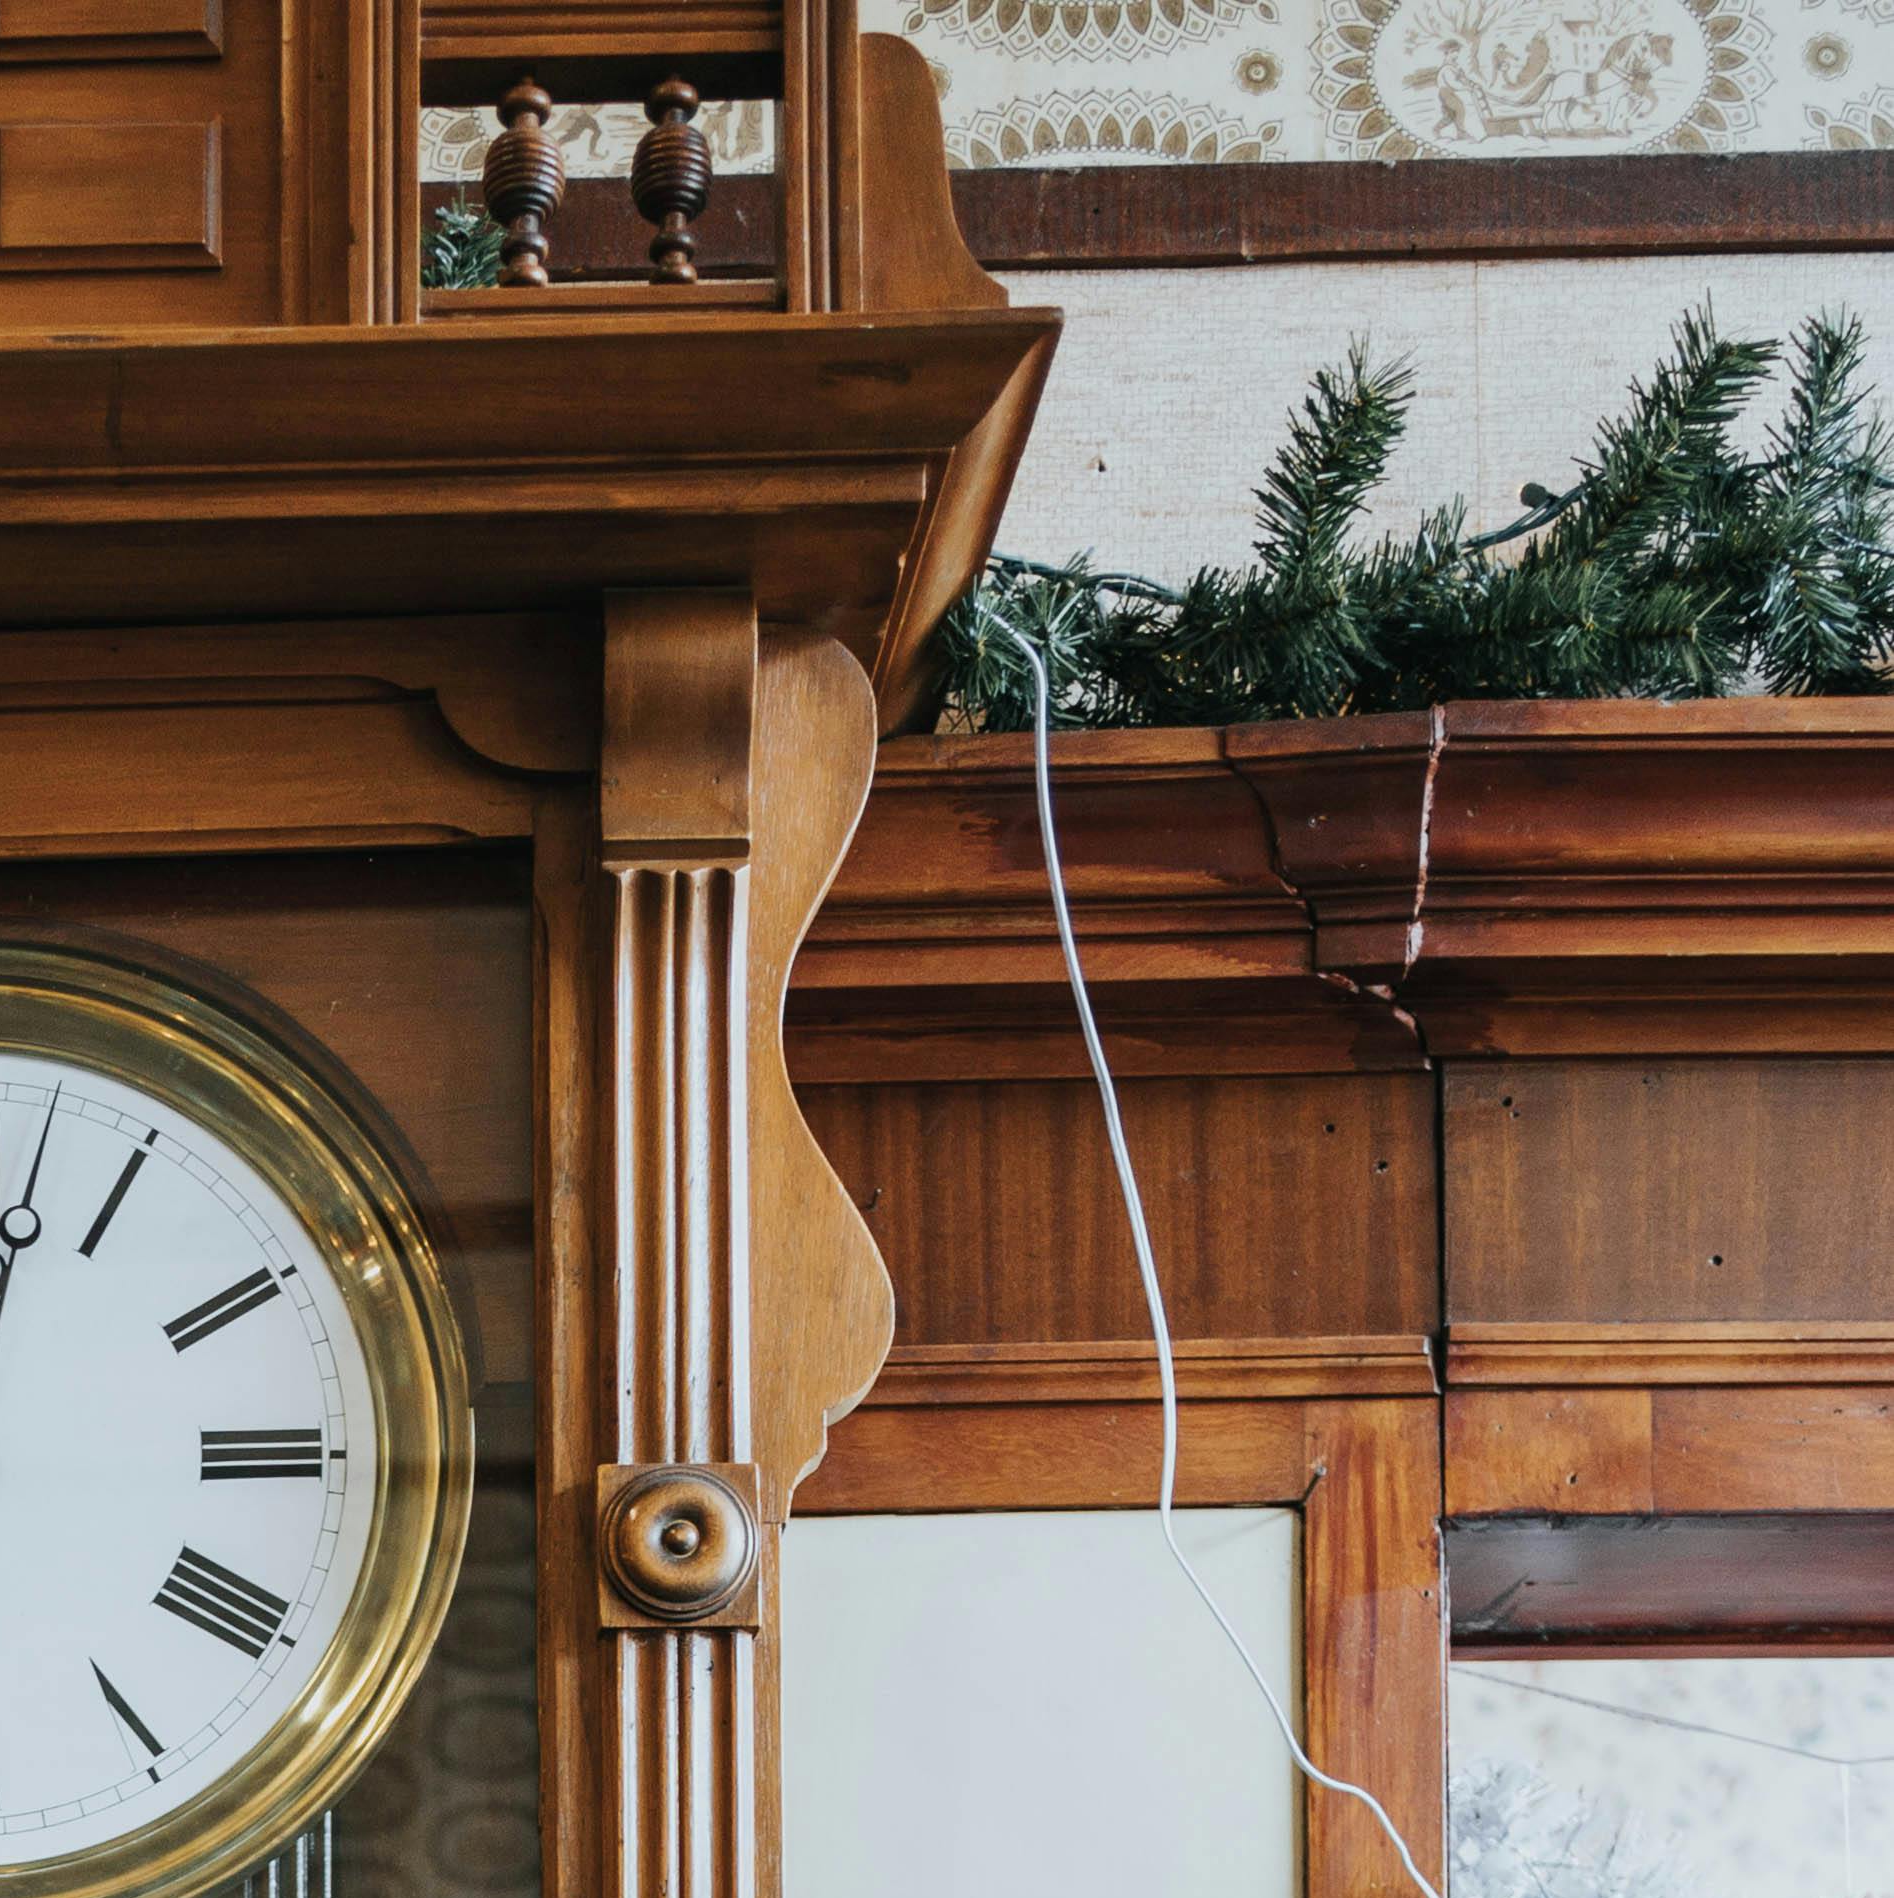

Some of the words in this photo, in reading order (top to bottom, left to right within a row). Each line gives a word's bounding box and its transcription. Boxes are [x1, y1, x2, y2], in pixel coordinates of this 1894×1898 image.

[74, 1147, 149, 1262] I
[160, 1265, 285, 1355] II
[198, 1426, 324, 1482] III
[88, 1656, 167, 1775] V
